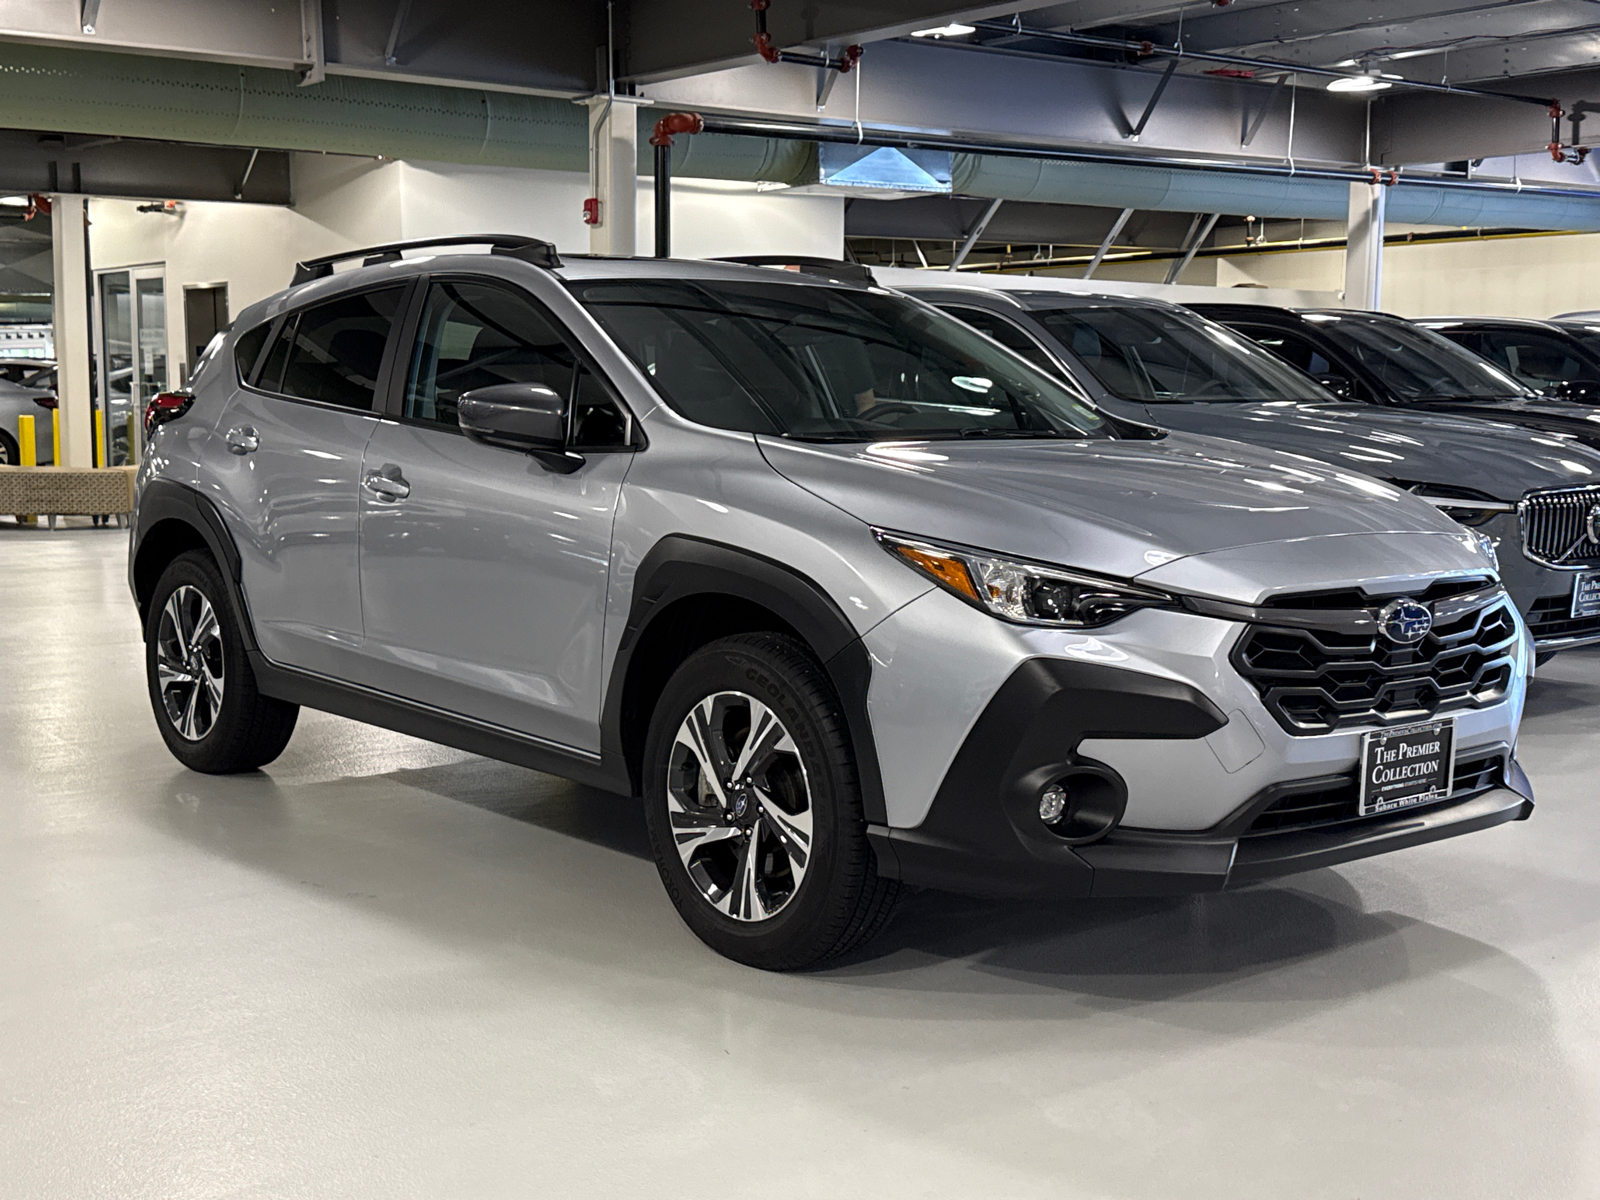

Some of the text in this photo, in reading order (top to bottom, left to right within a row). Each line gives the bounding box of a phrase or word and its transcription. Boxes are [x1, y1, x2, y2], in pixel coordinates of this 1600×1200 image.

[1374, 741, 1440, 765] THE PREMIER
[1372, 759, 1440, 784] COLLECTION
[1375, 801, 1398, 812] Subaru
[1399, 796, 1417, 807] White
